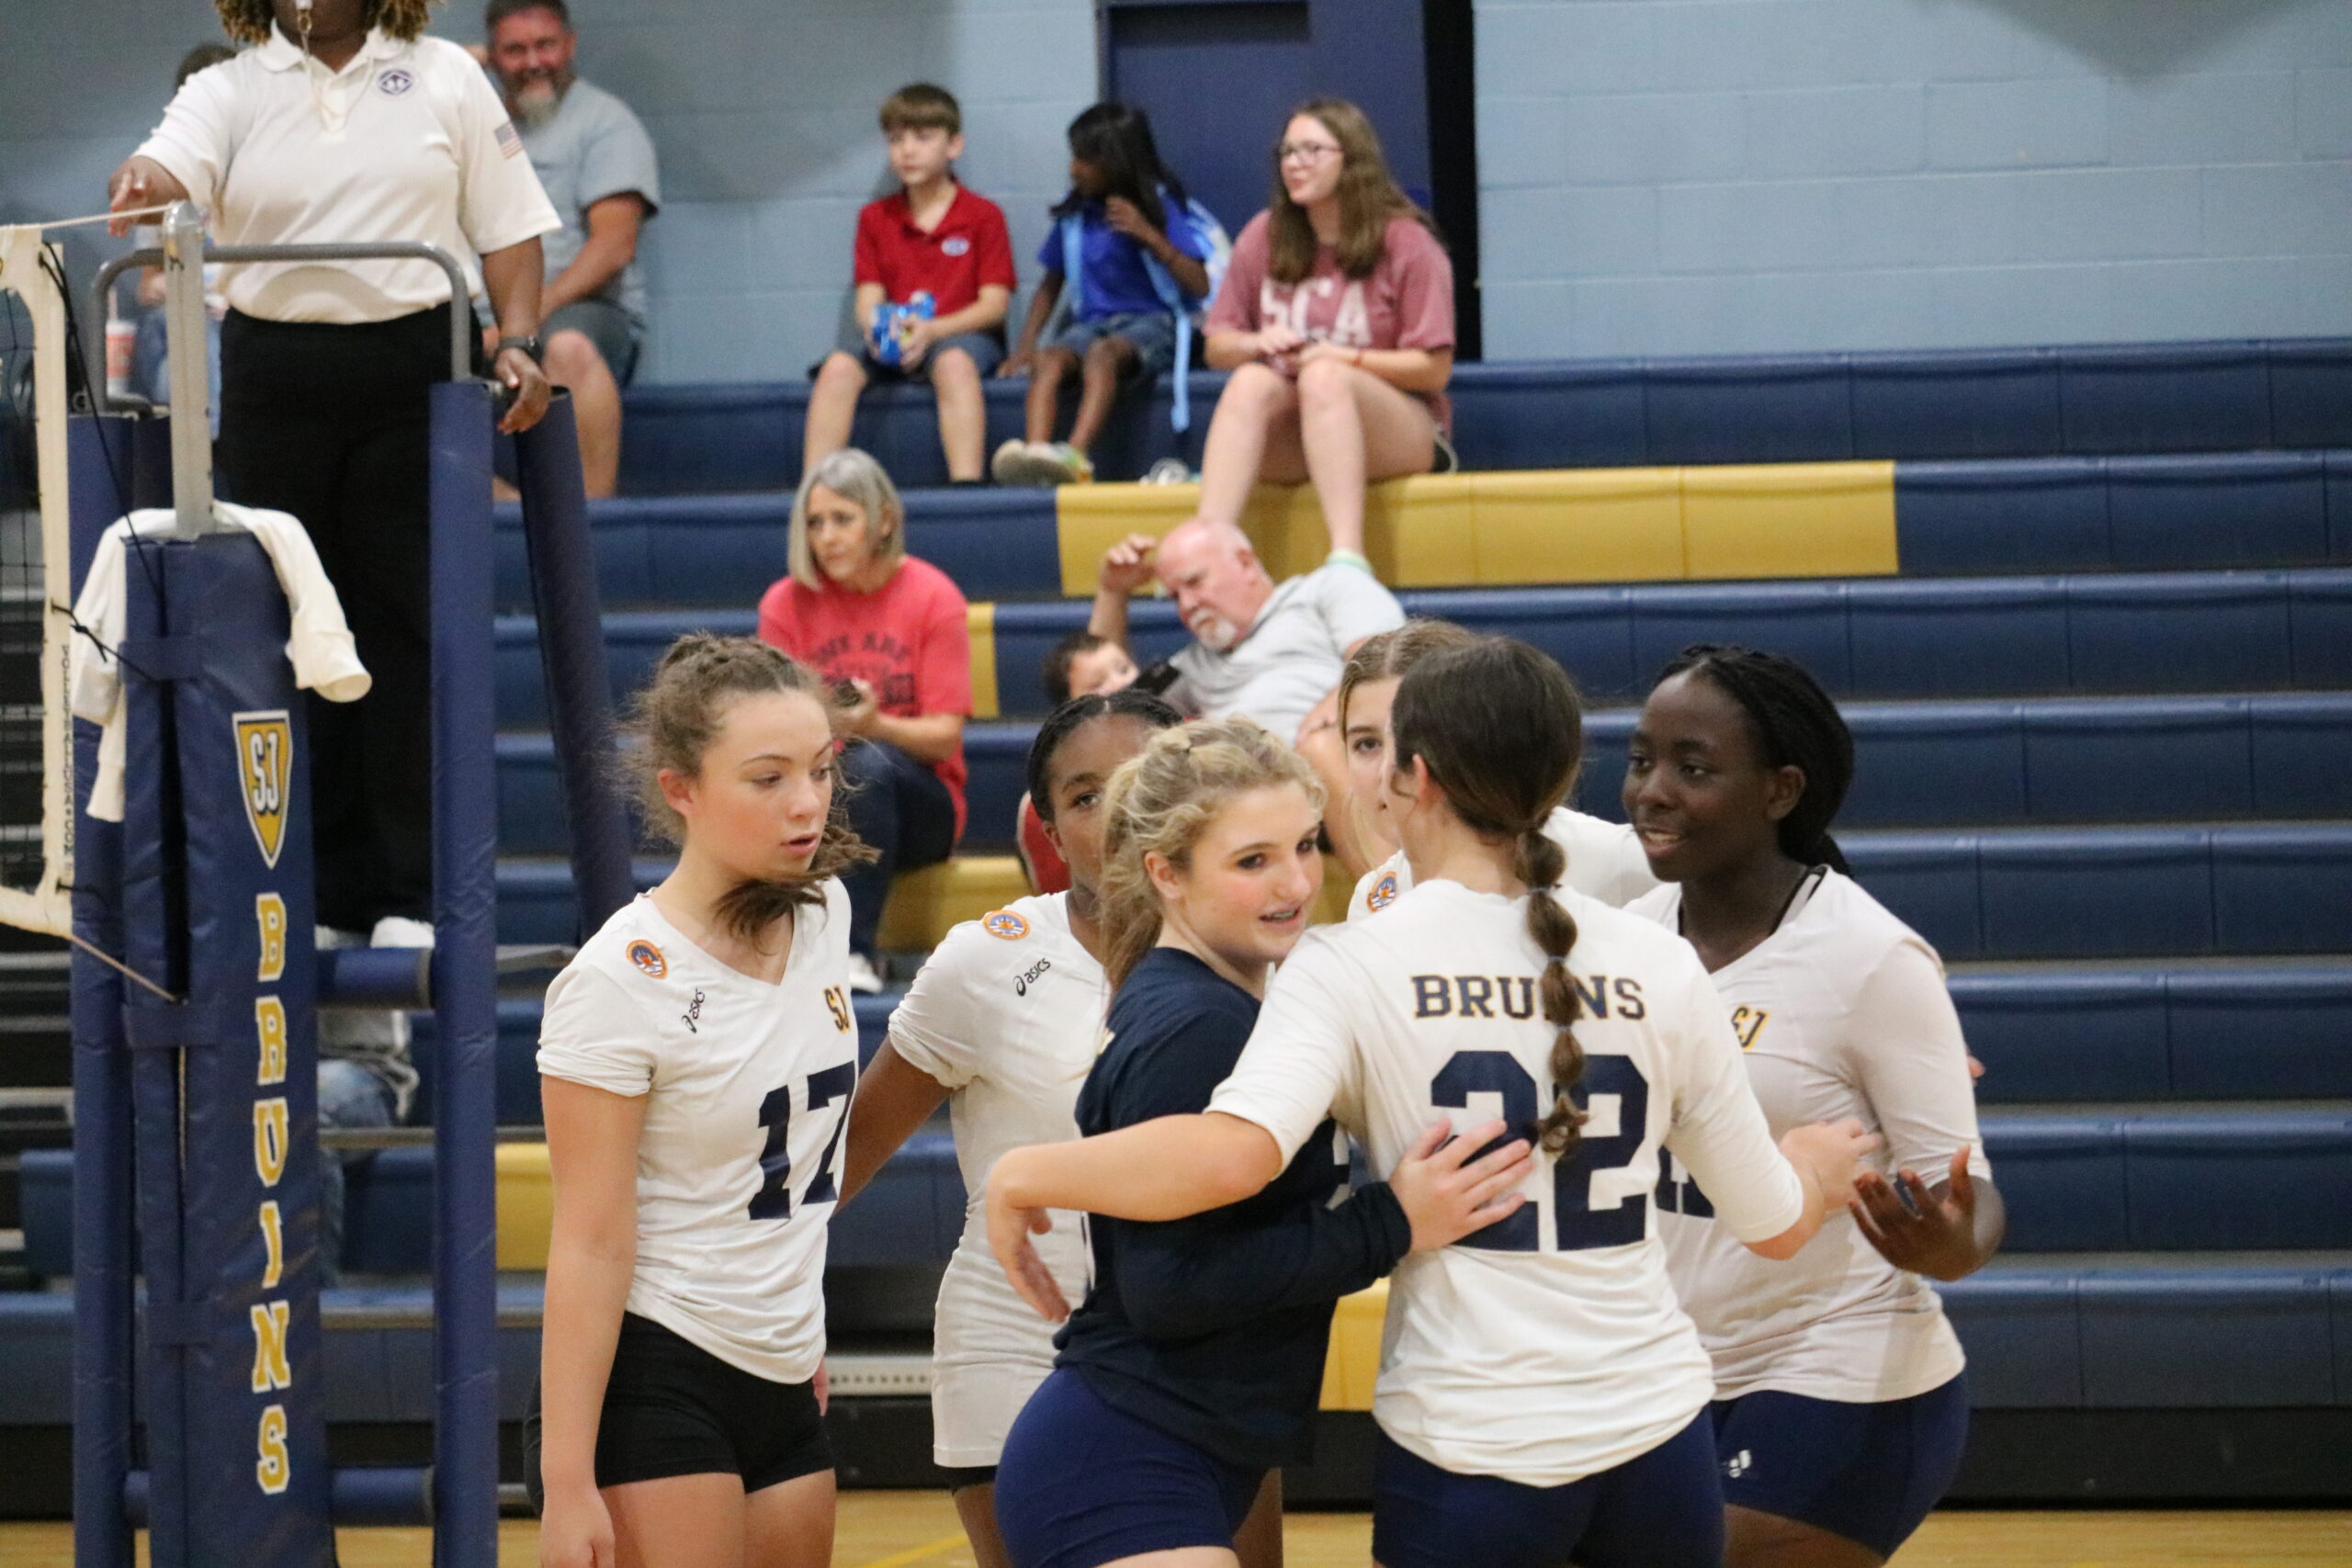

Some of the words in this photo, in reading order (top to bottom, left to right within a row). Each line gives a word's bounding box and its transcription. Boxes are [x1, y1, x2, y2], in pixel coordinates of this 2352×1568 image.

[249, 730, 279, 814] SJ
[823, 985, 851, 1033] SJ
[1410, 975, 1647, 1021] BRUNS
[251, 893, 291, 1495] BRUINS
[747, 1059, 856, 1221] 17
[1430, 1050, 1649, 1252] 22
